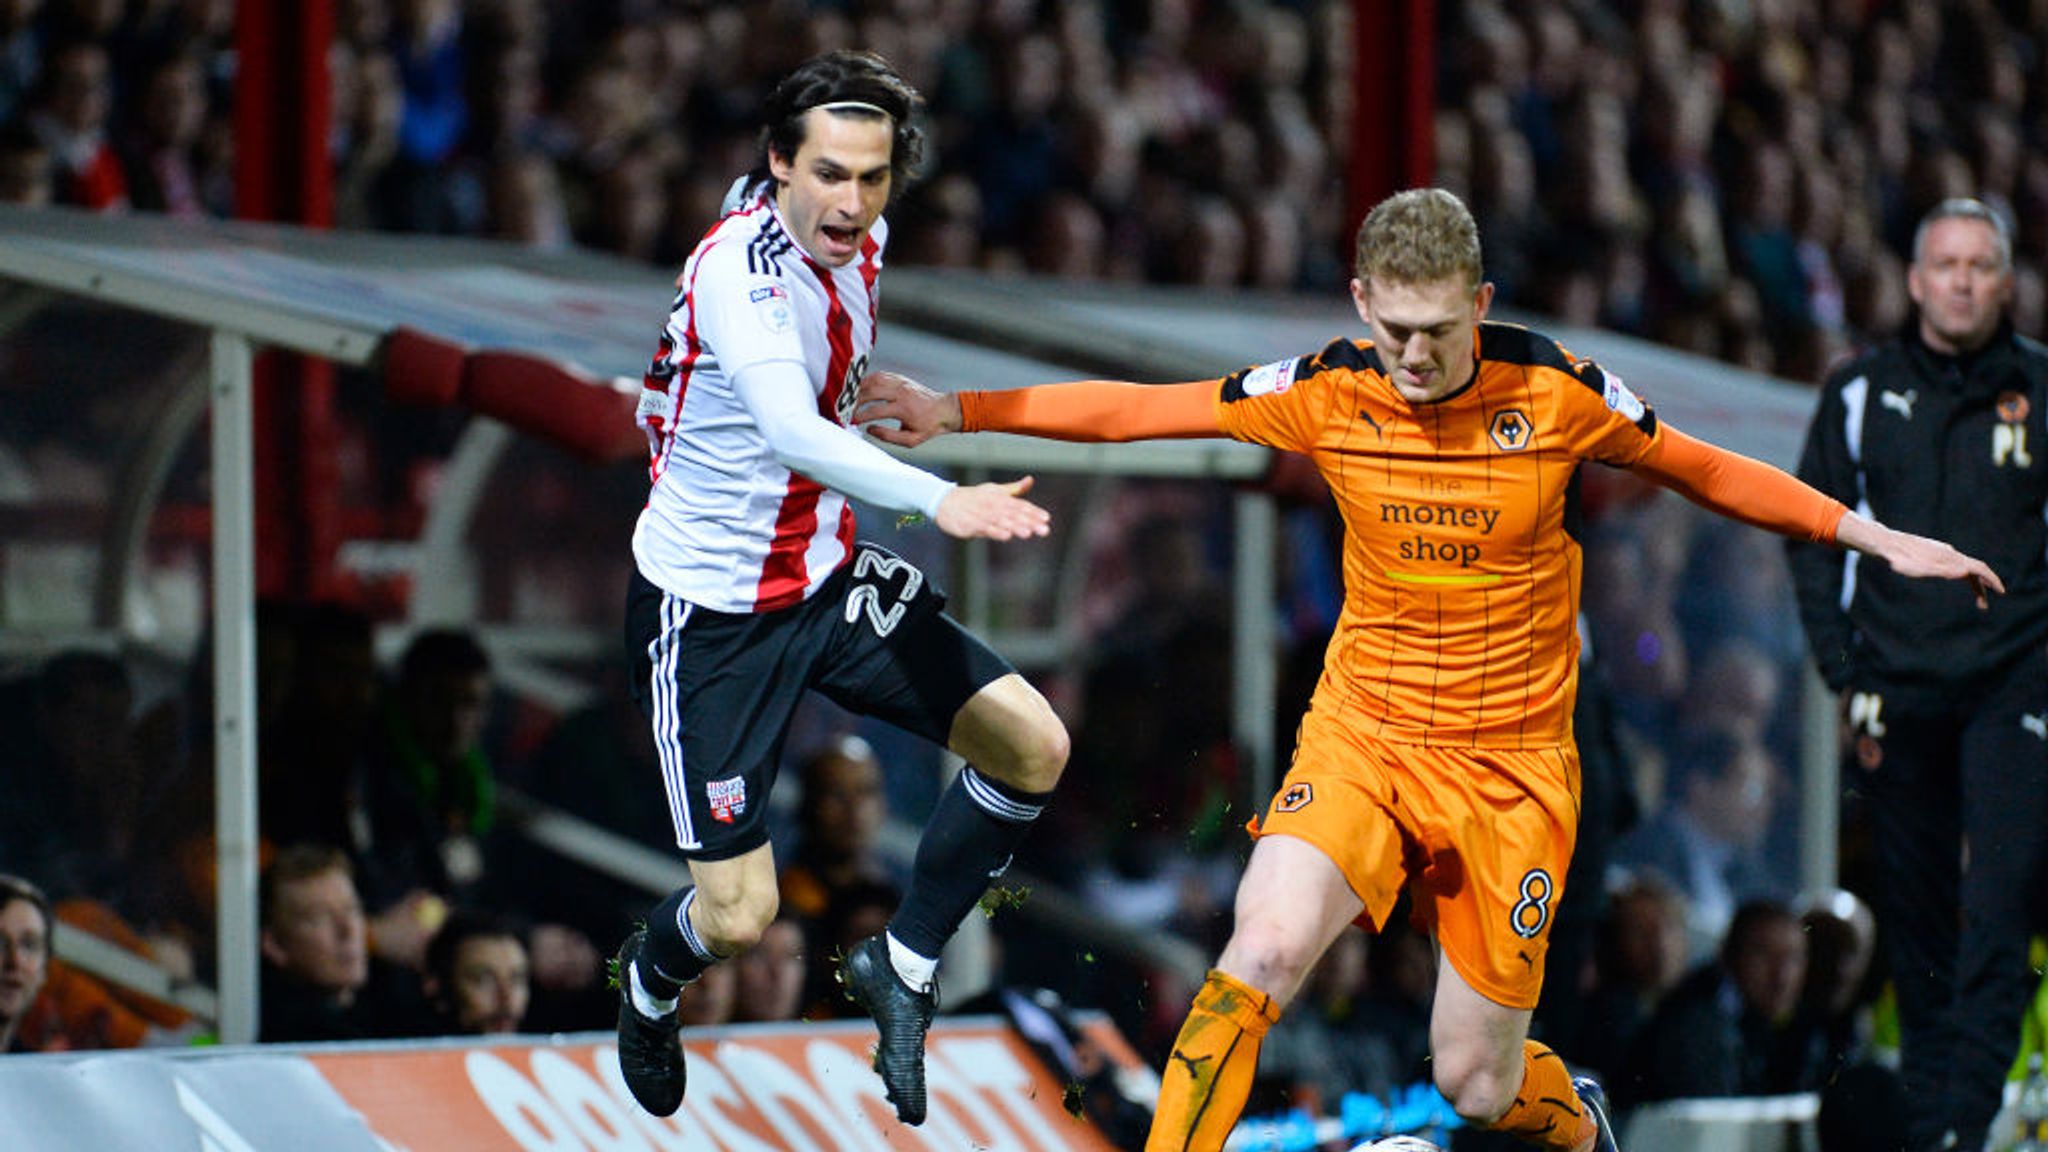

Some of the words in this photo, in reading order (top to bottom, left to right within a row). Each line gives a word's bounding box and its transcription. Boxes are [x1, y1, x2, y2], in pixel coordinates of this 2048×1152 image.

[1993, 423, 2032, 467] PL
[1419, 471, 1462, 494] the
[1380, 503, 1500, 535] money
[1399, 535, 1481, 568] shop
[845, 550, 923, 637] 23
[1509, 867, 1553, 939] 8
